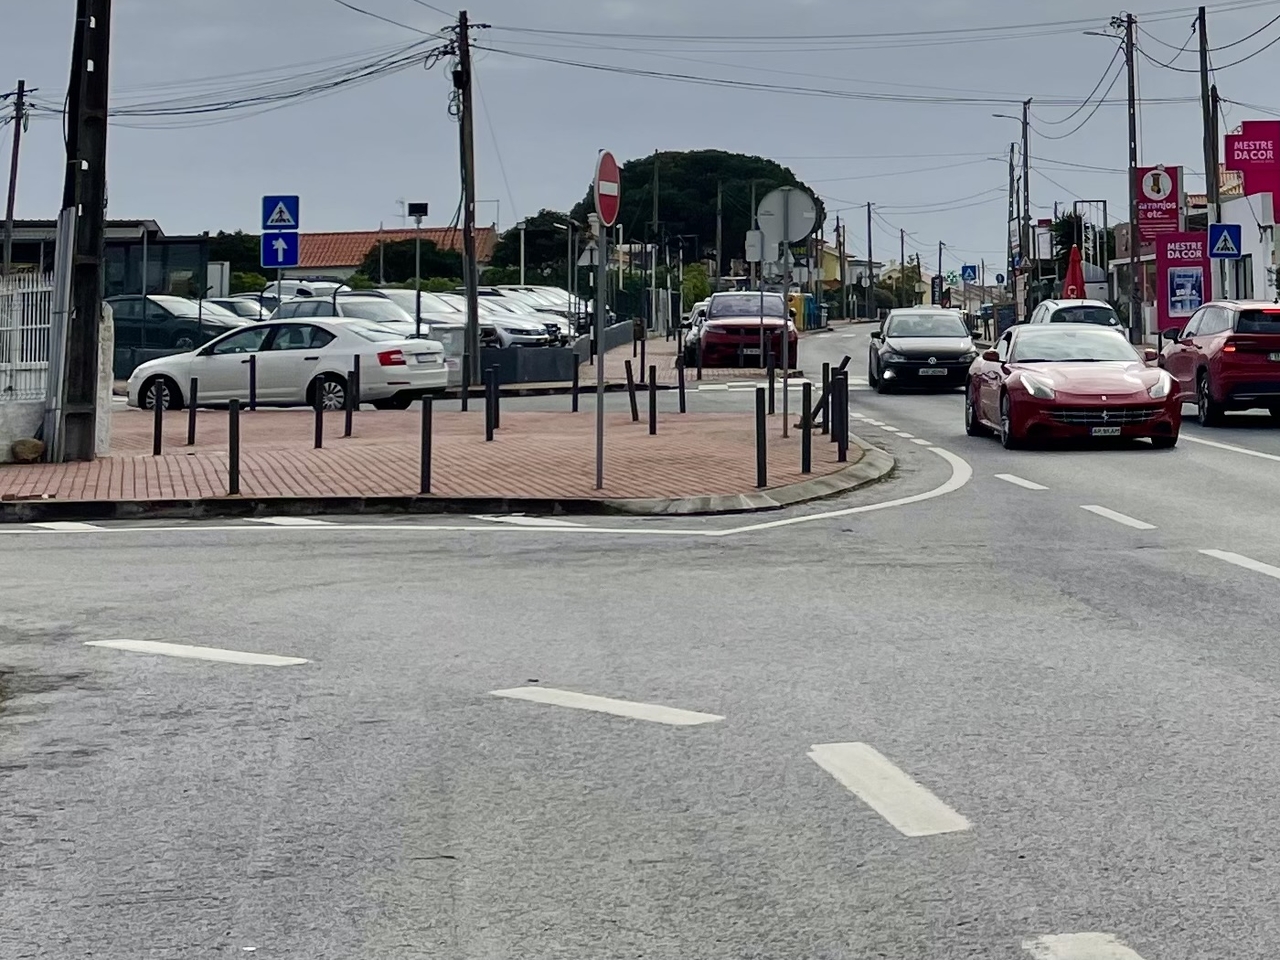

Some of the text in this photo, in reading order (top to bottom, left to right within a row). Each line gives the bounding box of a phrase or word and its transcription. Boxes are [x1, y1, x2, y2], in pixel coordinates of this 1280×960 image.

[1234, 141, 1273, 150] MESTRE
[1234, 150, 1274, 160] DA COR
[1167, 241, 1203, 250] MESTRE
[1167, 250, 1202, 259] DA COR
